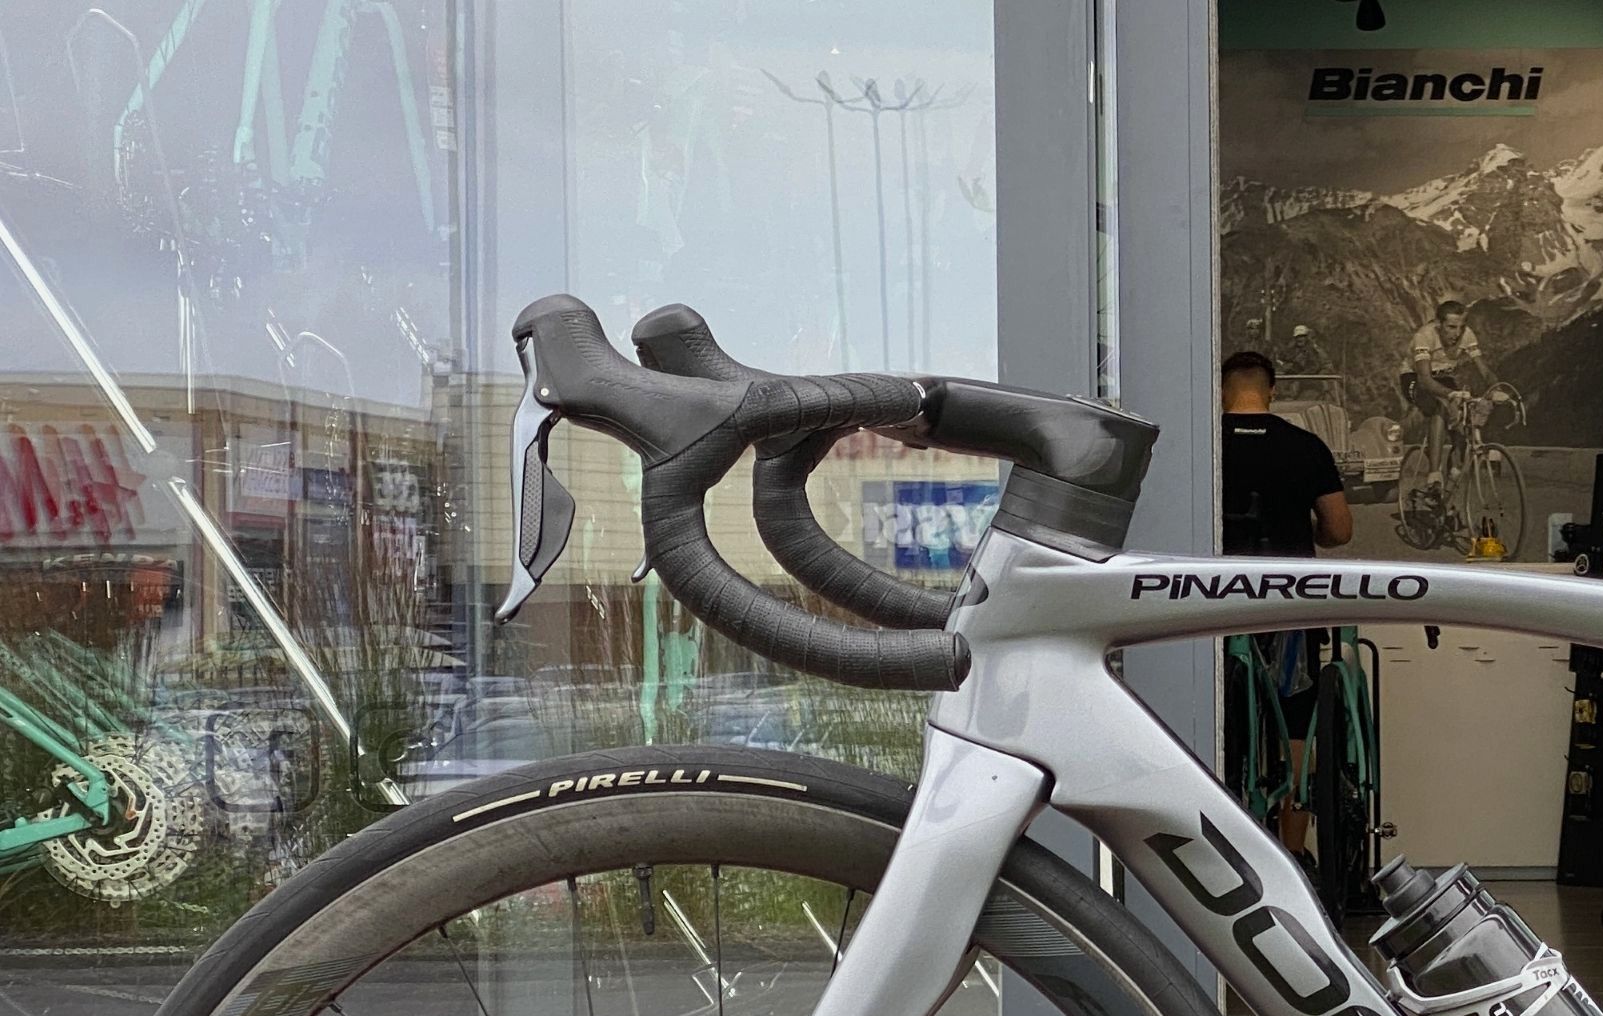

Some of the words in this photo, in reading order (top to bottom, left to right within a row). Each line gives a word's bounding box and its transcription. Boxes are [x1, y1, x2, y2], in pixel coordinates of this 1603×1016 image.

[1308, 67, 1544, 101] Bianchi
[1130, 574, 1429, 601] PINARELLO
[548, 769, 711, 797] PIRELLI
[1533, 967, 1560, 981] Tacx
